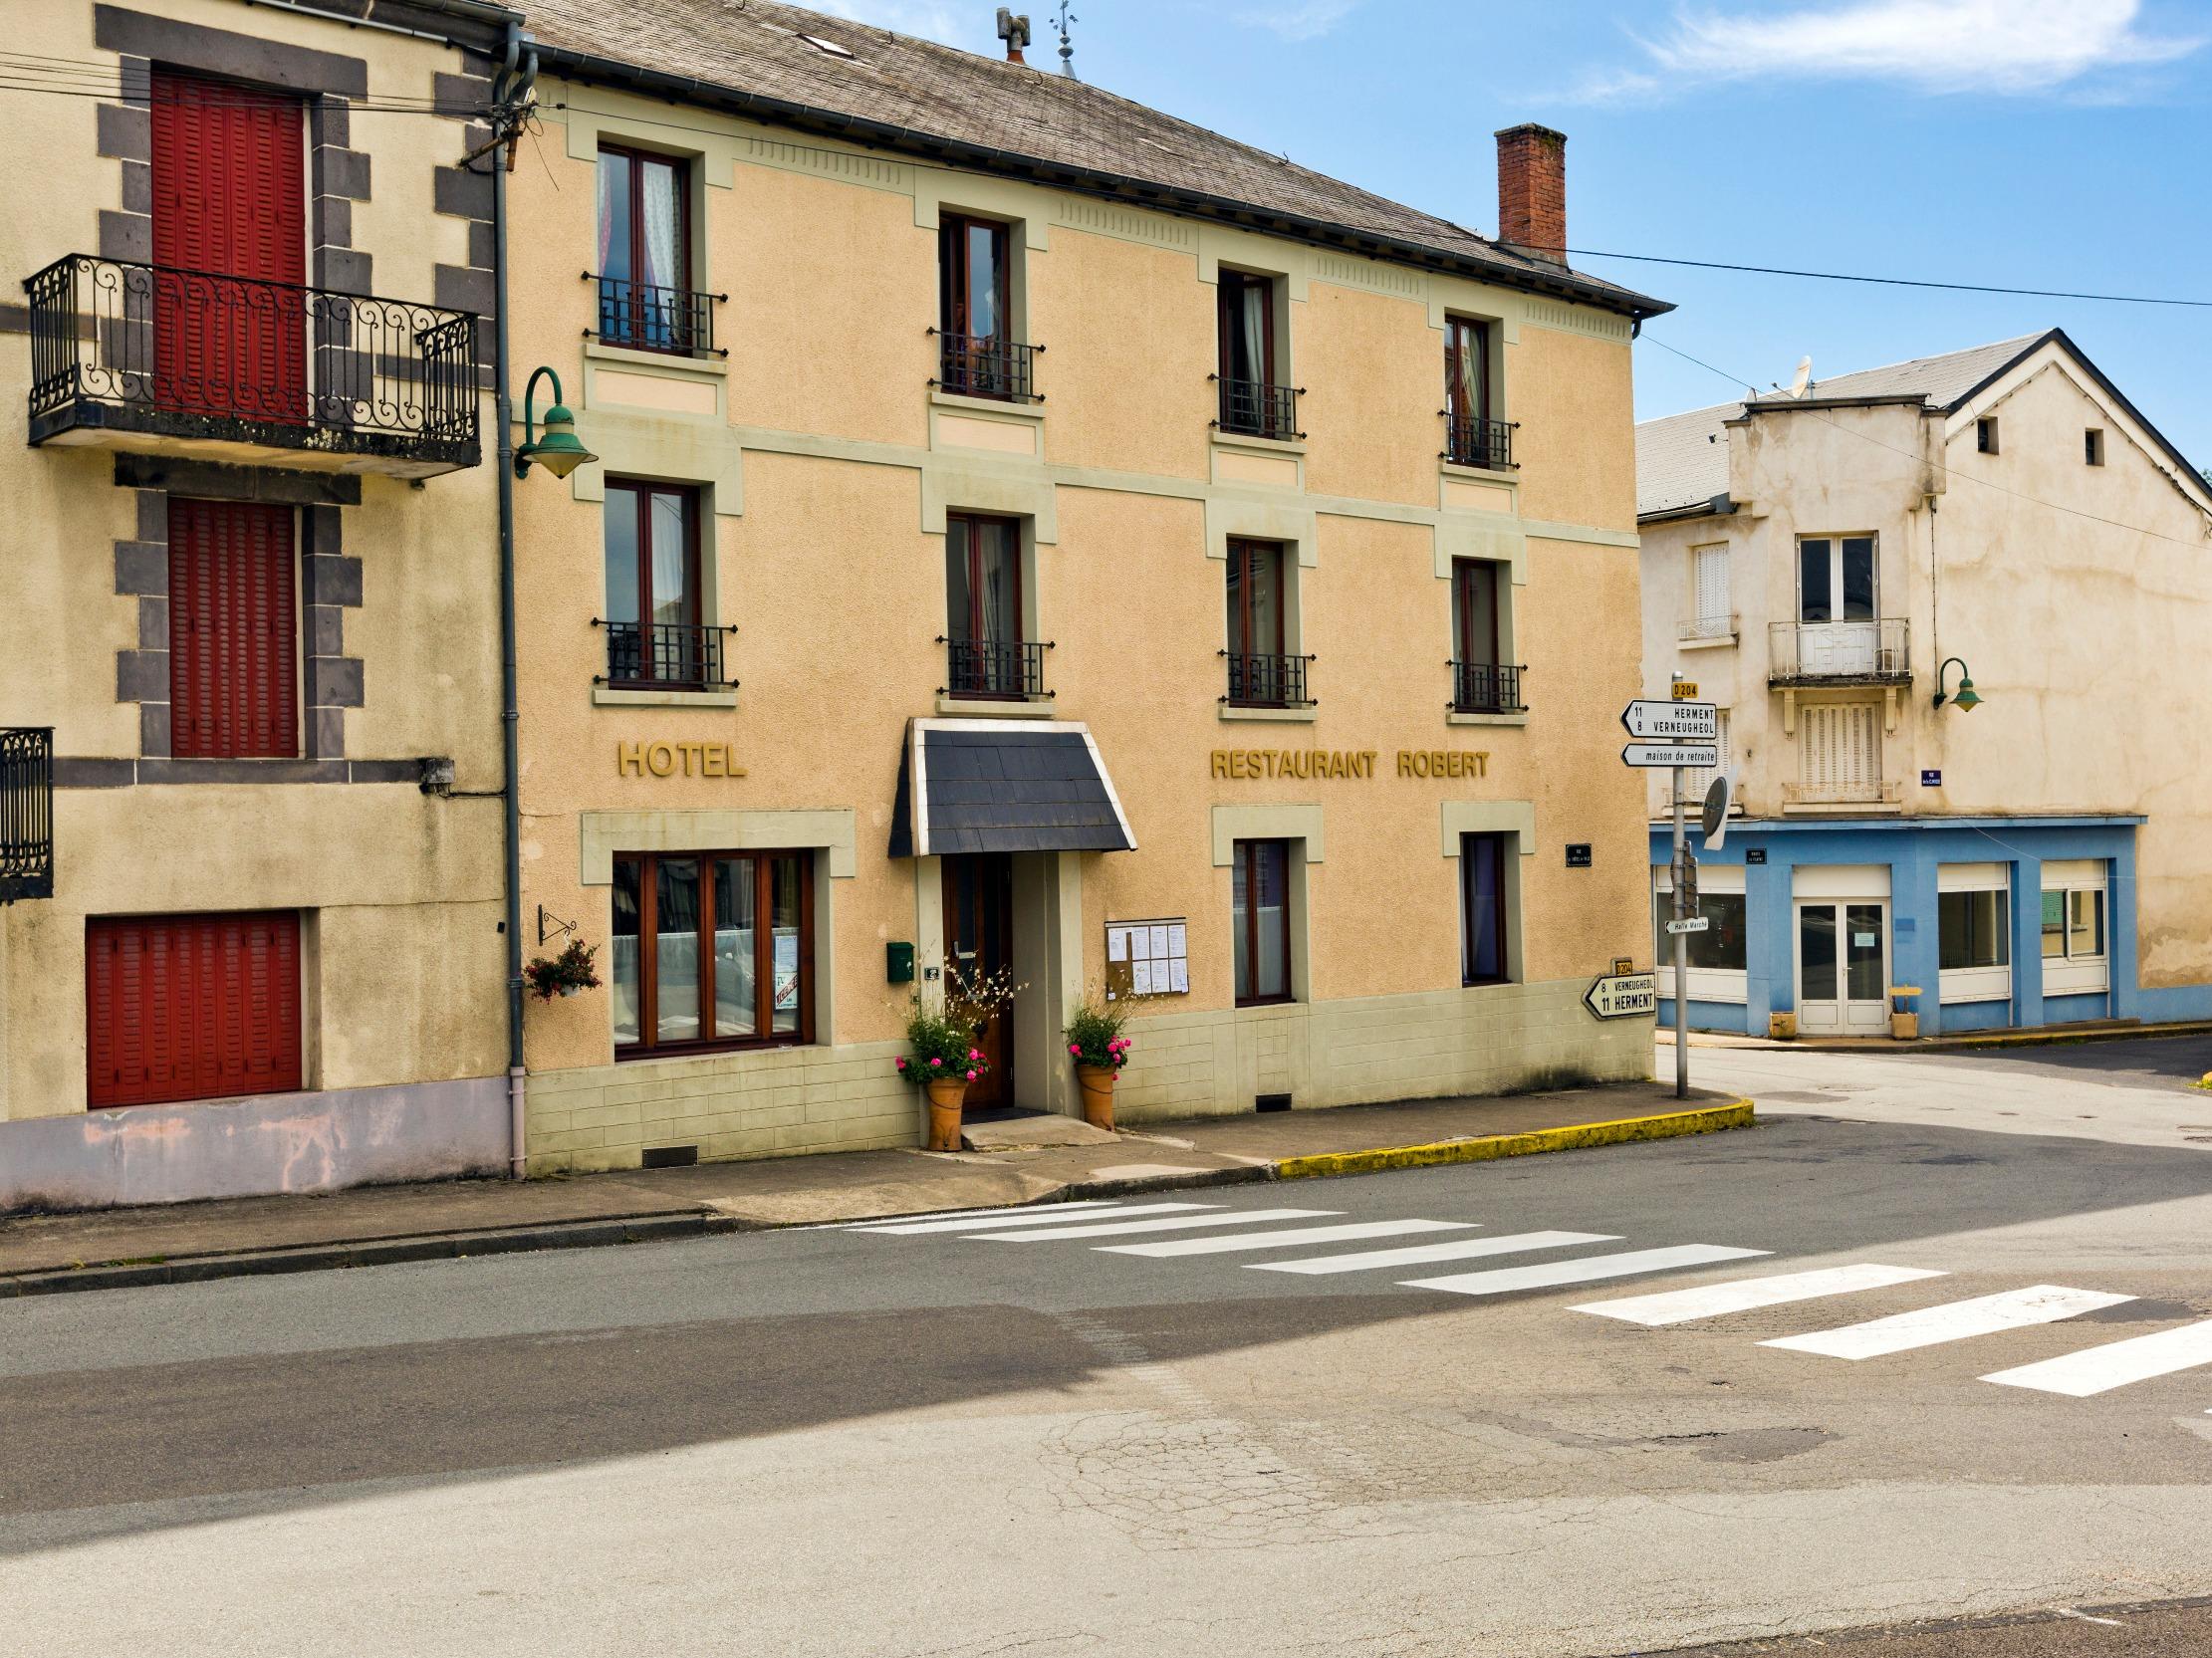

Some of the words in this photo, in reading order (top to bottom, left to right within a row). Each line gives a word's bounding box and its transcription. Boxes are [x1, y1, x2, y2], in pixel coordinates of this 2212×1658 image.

[1634, 706, 1642, 717] 11
[1674, 708, 1714, 720] HERMENT
[1637, 720, 1642, 732] 8
[1653, 721, 1714, 734] VERNEUGHEOL
[618, 740, 749, 777] HOTEL
[1645, 750, 1672, 761] maison
[1675, 751, 1684, 761] de
[1687, 751, 1714, 762] retraite
[1210, 749, 1377, 779] RESTAURANT
[1397, 750, 1490, 778] ROBERT
[1601, 983, 1606, 993] 8
[1614, 979, 1653, 992] VERNEUGHEOL
[1601, 997, 1609, 1011] 11
[1614, 993, 1653, 1010] HERMENT
